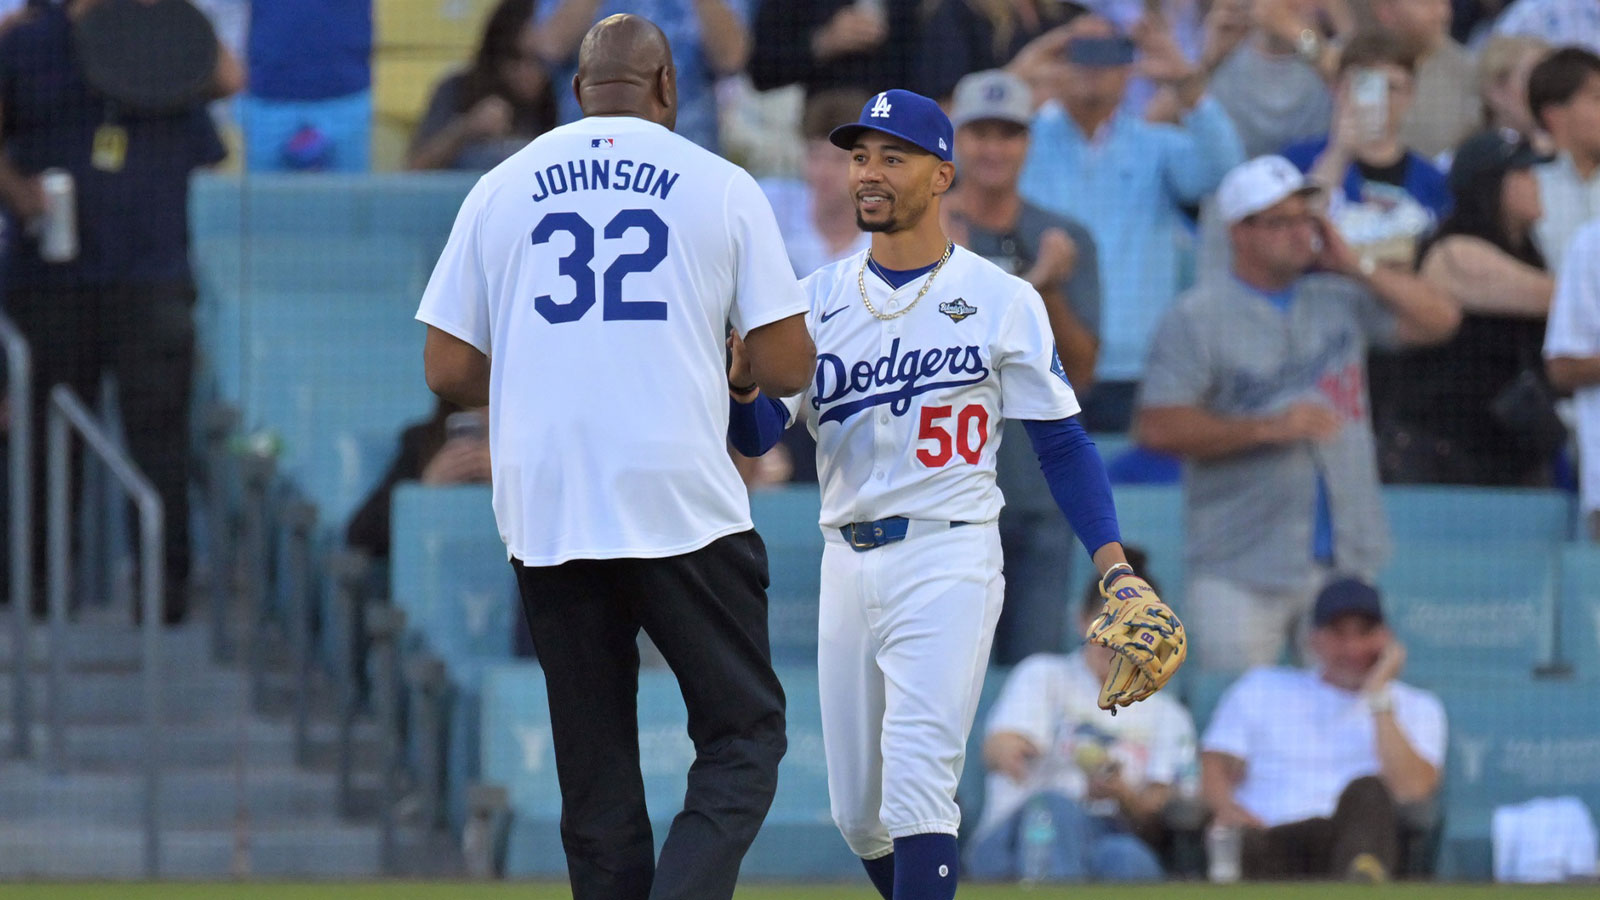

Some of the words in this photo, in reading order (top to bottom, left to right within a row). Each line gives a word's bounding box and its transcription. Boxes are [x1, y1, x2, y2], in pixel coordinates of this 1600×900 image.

[871, 92, 892, 118] LA
[532, 159, 681, 203] JOHNSON
[531, 208, 669, 324] 32
[811, 337, 989, 418] Dodgers
[916, 403, 989, 468] 50
